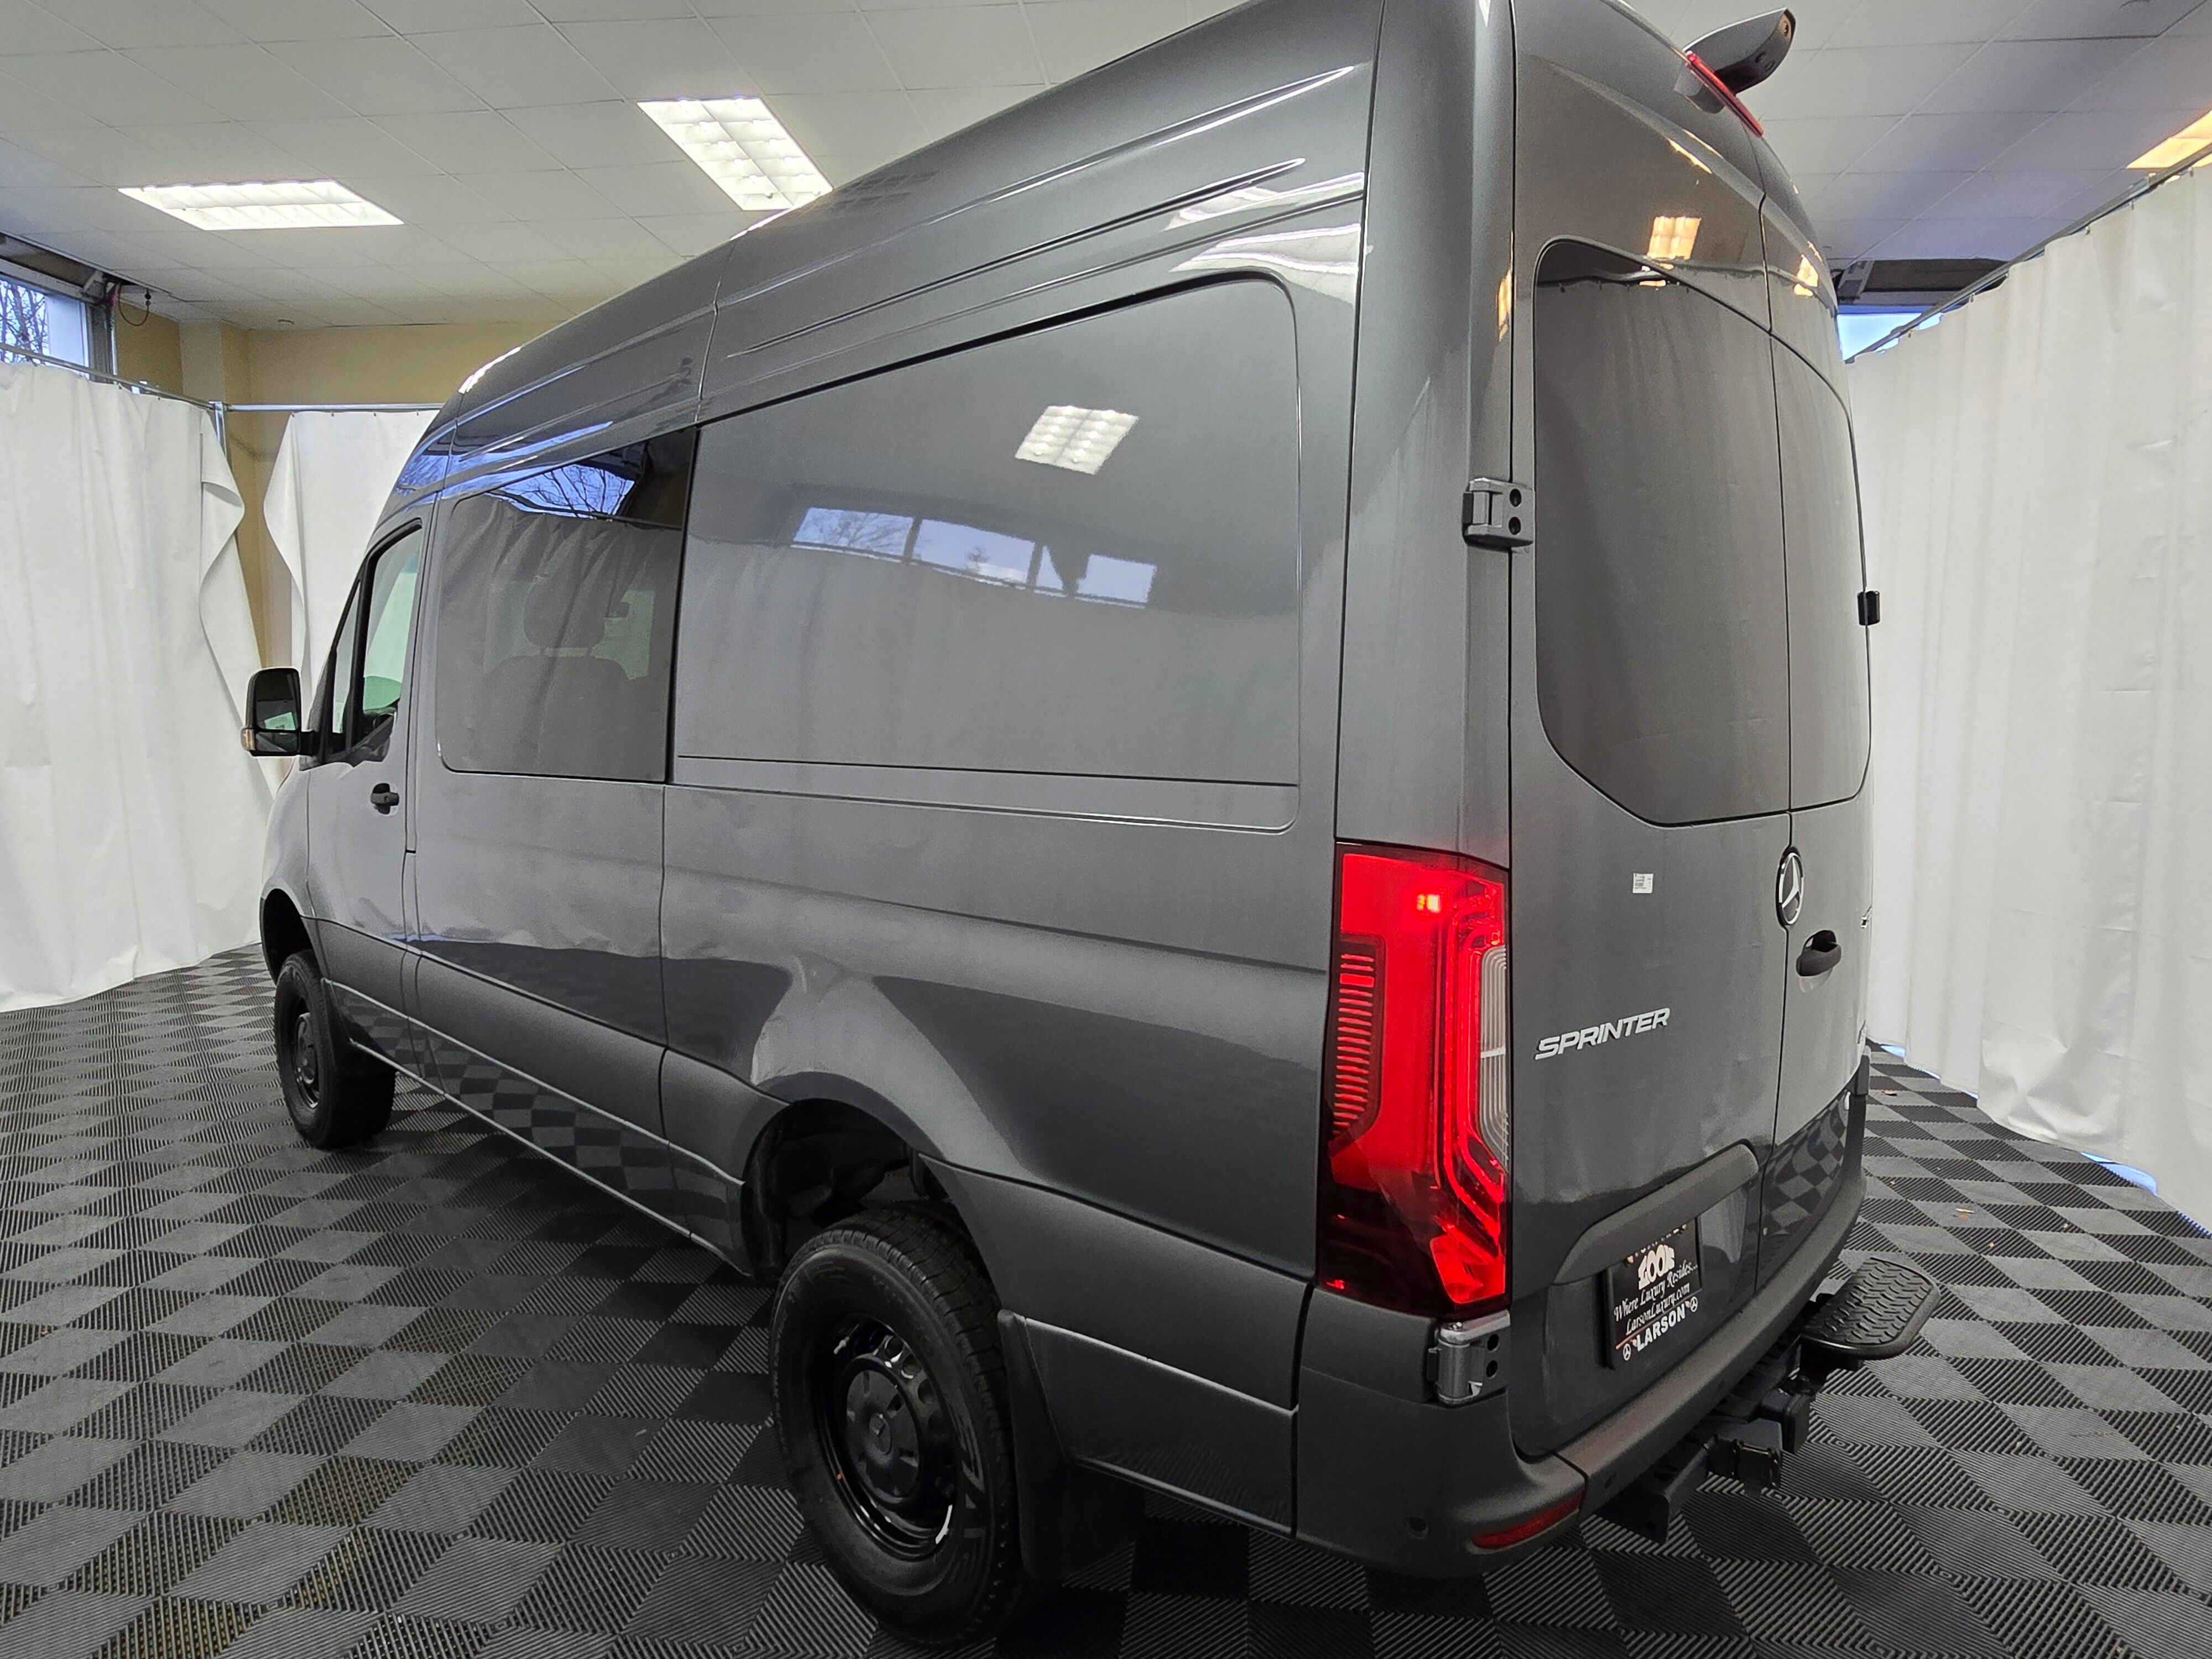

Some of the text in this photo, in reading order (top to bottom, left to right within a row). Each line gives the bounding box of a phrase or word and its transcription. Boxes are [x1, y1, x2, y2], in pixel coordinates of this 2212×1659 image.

[1535, 1008, 1670, 1060] SPRINTER
[1614, 1297, 1639, 1321] Where
[1640, 1280, 1665, 1306] Luxury
[1626, 1282, 1690, 1335] LarsonLuxury.com
[1636, 1303, 1686, 1352] LARSON
